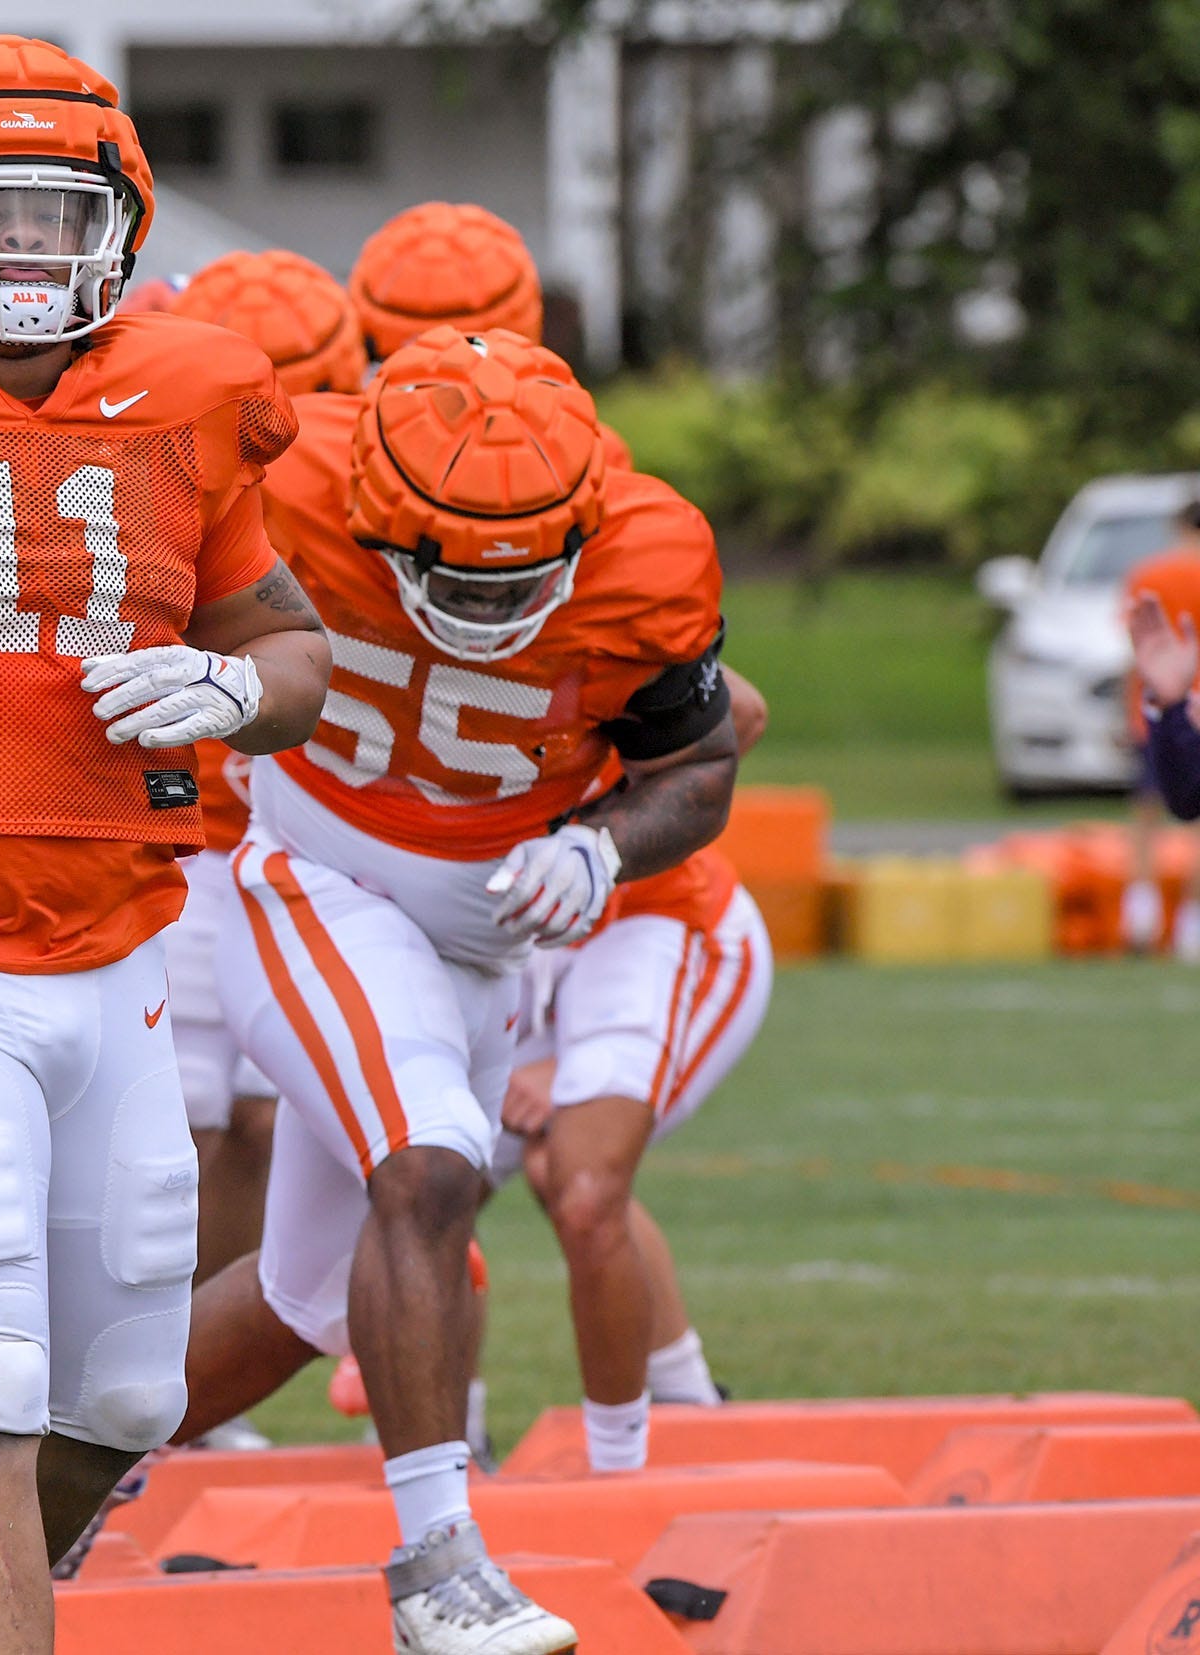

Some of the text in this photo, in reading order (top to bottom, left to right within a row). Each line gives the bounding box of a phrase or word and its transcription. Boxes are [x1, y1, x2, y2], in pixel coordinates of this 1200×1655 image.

[0, 120, 54, 129] GUARDIAN
[12, 292, 48, 304] ALL IN
[302, 627, 552, 807] 55
